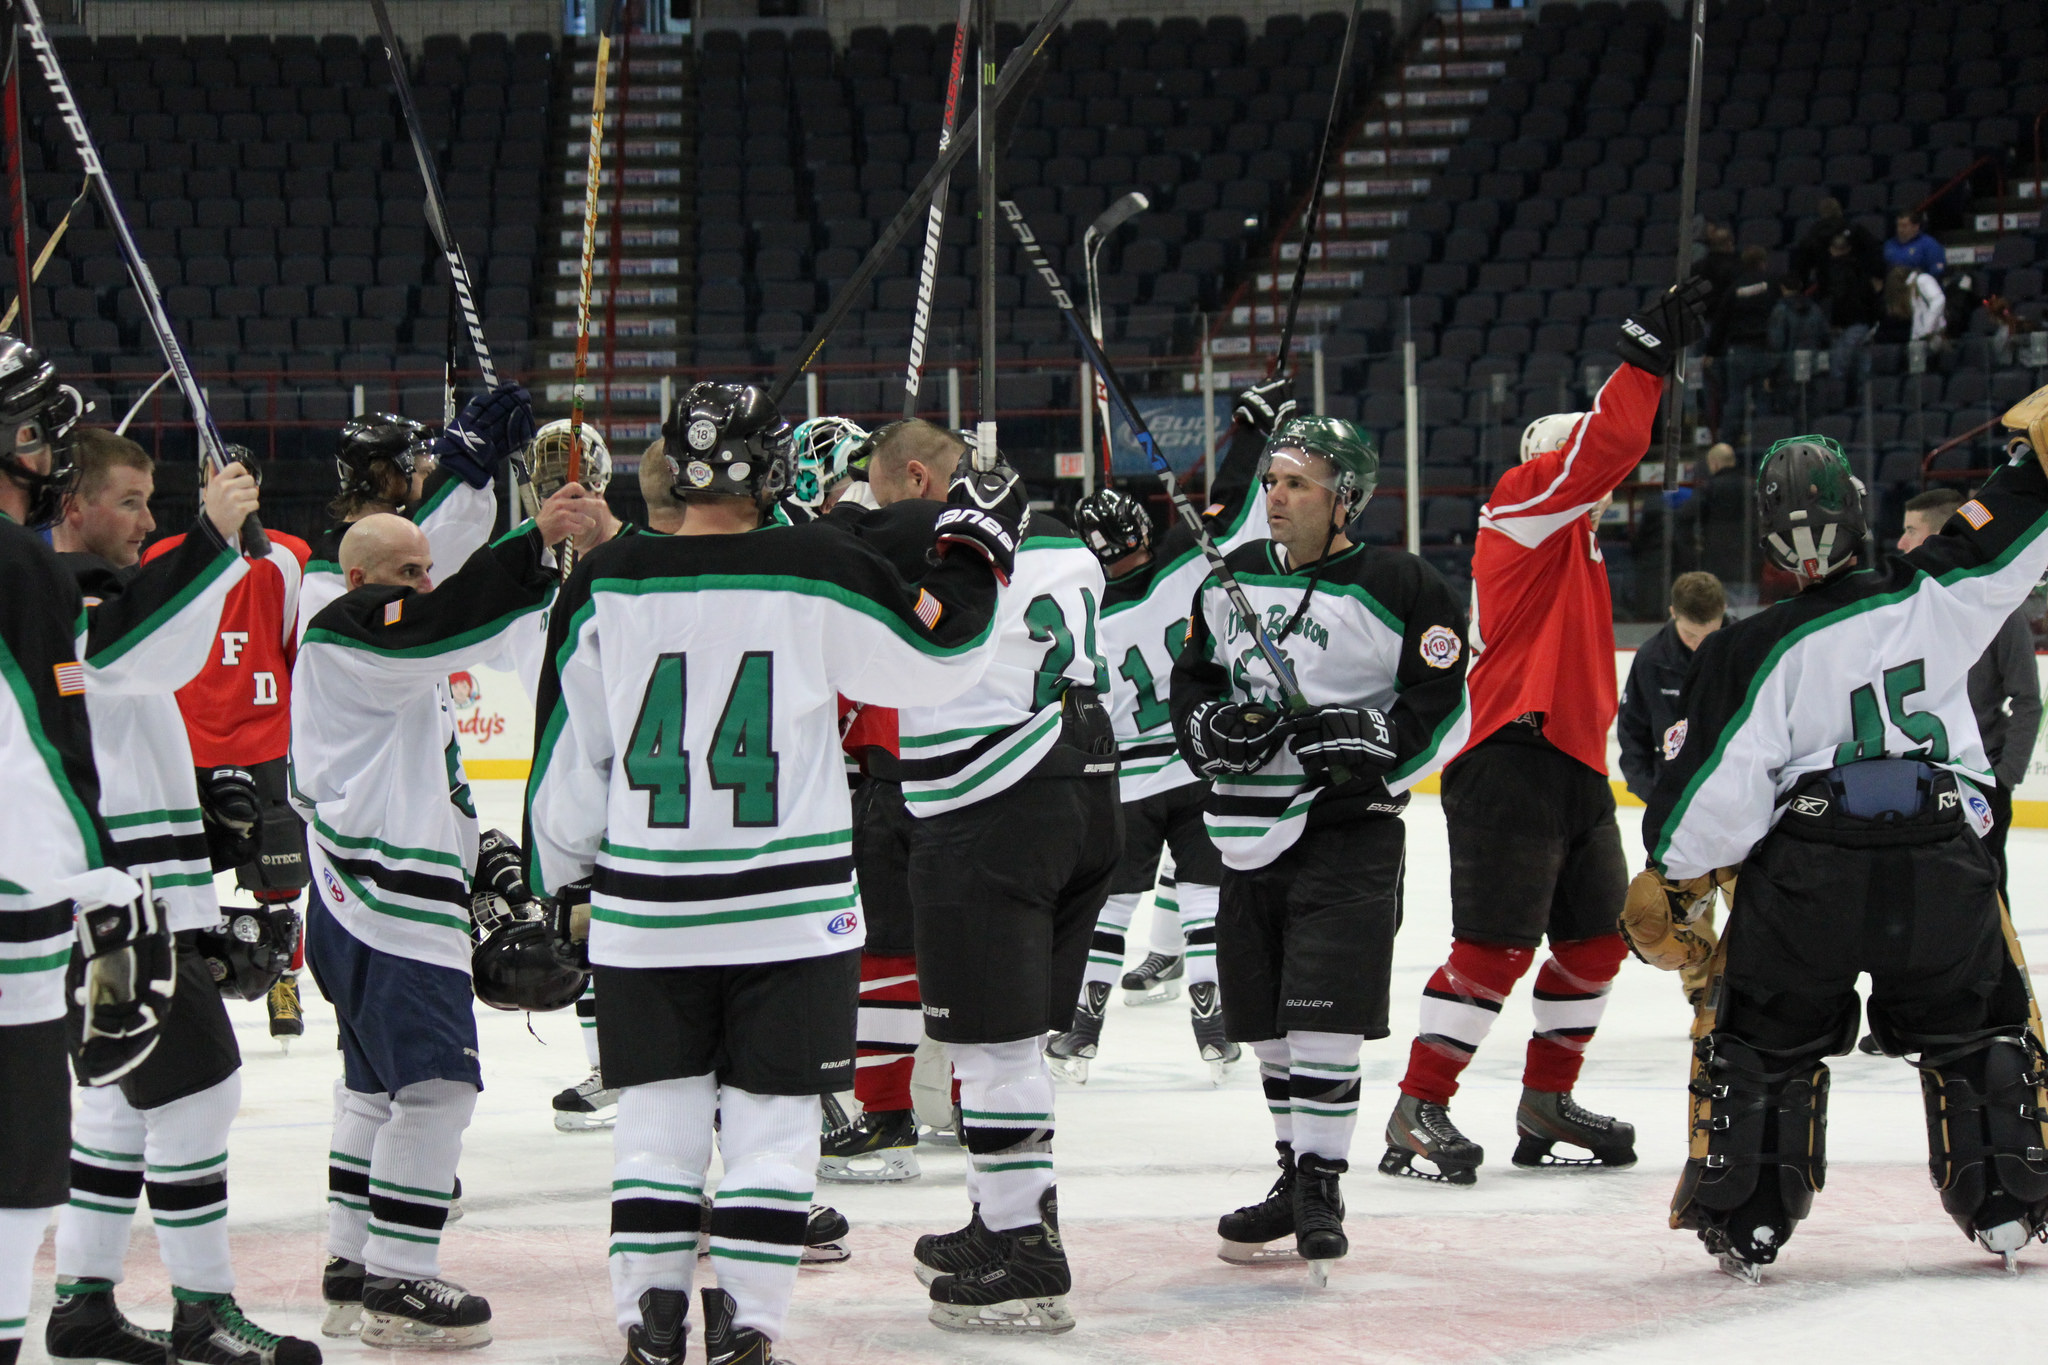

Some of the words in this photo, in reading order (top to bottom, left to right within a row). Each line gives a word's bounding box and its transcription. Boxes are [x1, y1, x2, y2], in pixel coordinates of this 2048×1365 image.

[906, 204, 942, 397] WARRIOR
[696, 429, 708, 440] 18
[221, 631, 249, 666] F
[1433, 640, 1446, 652] 18
[252, 671, 279, 705] D
[623, 651, 779, 829] 44
[1286, 999, 1334, 1009] BAUER
[820, 1058, 851, 1072] BAUER
[981, 1270, 1005, 1284] BAUER
